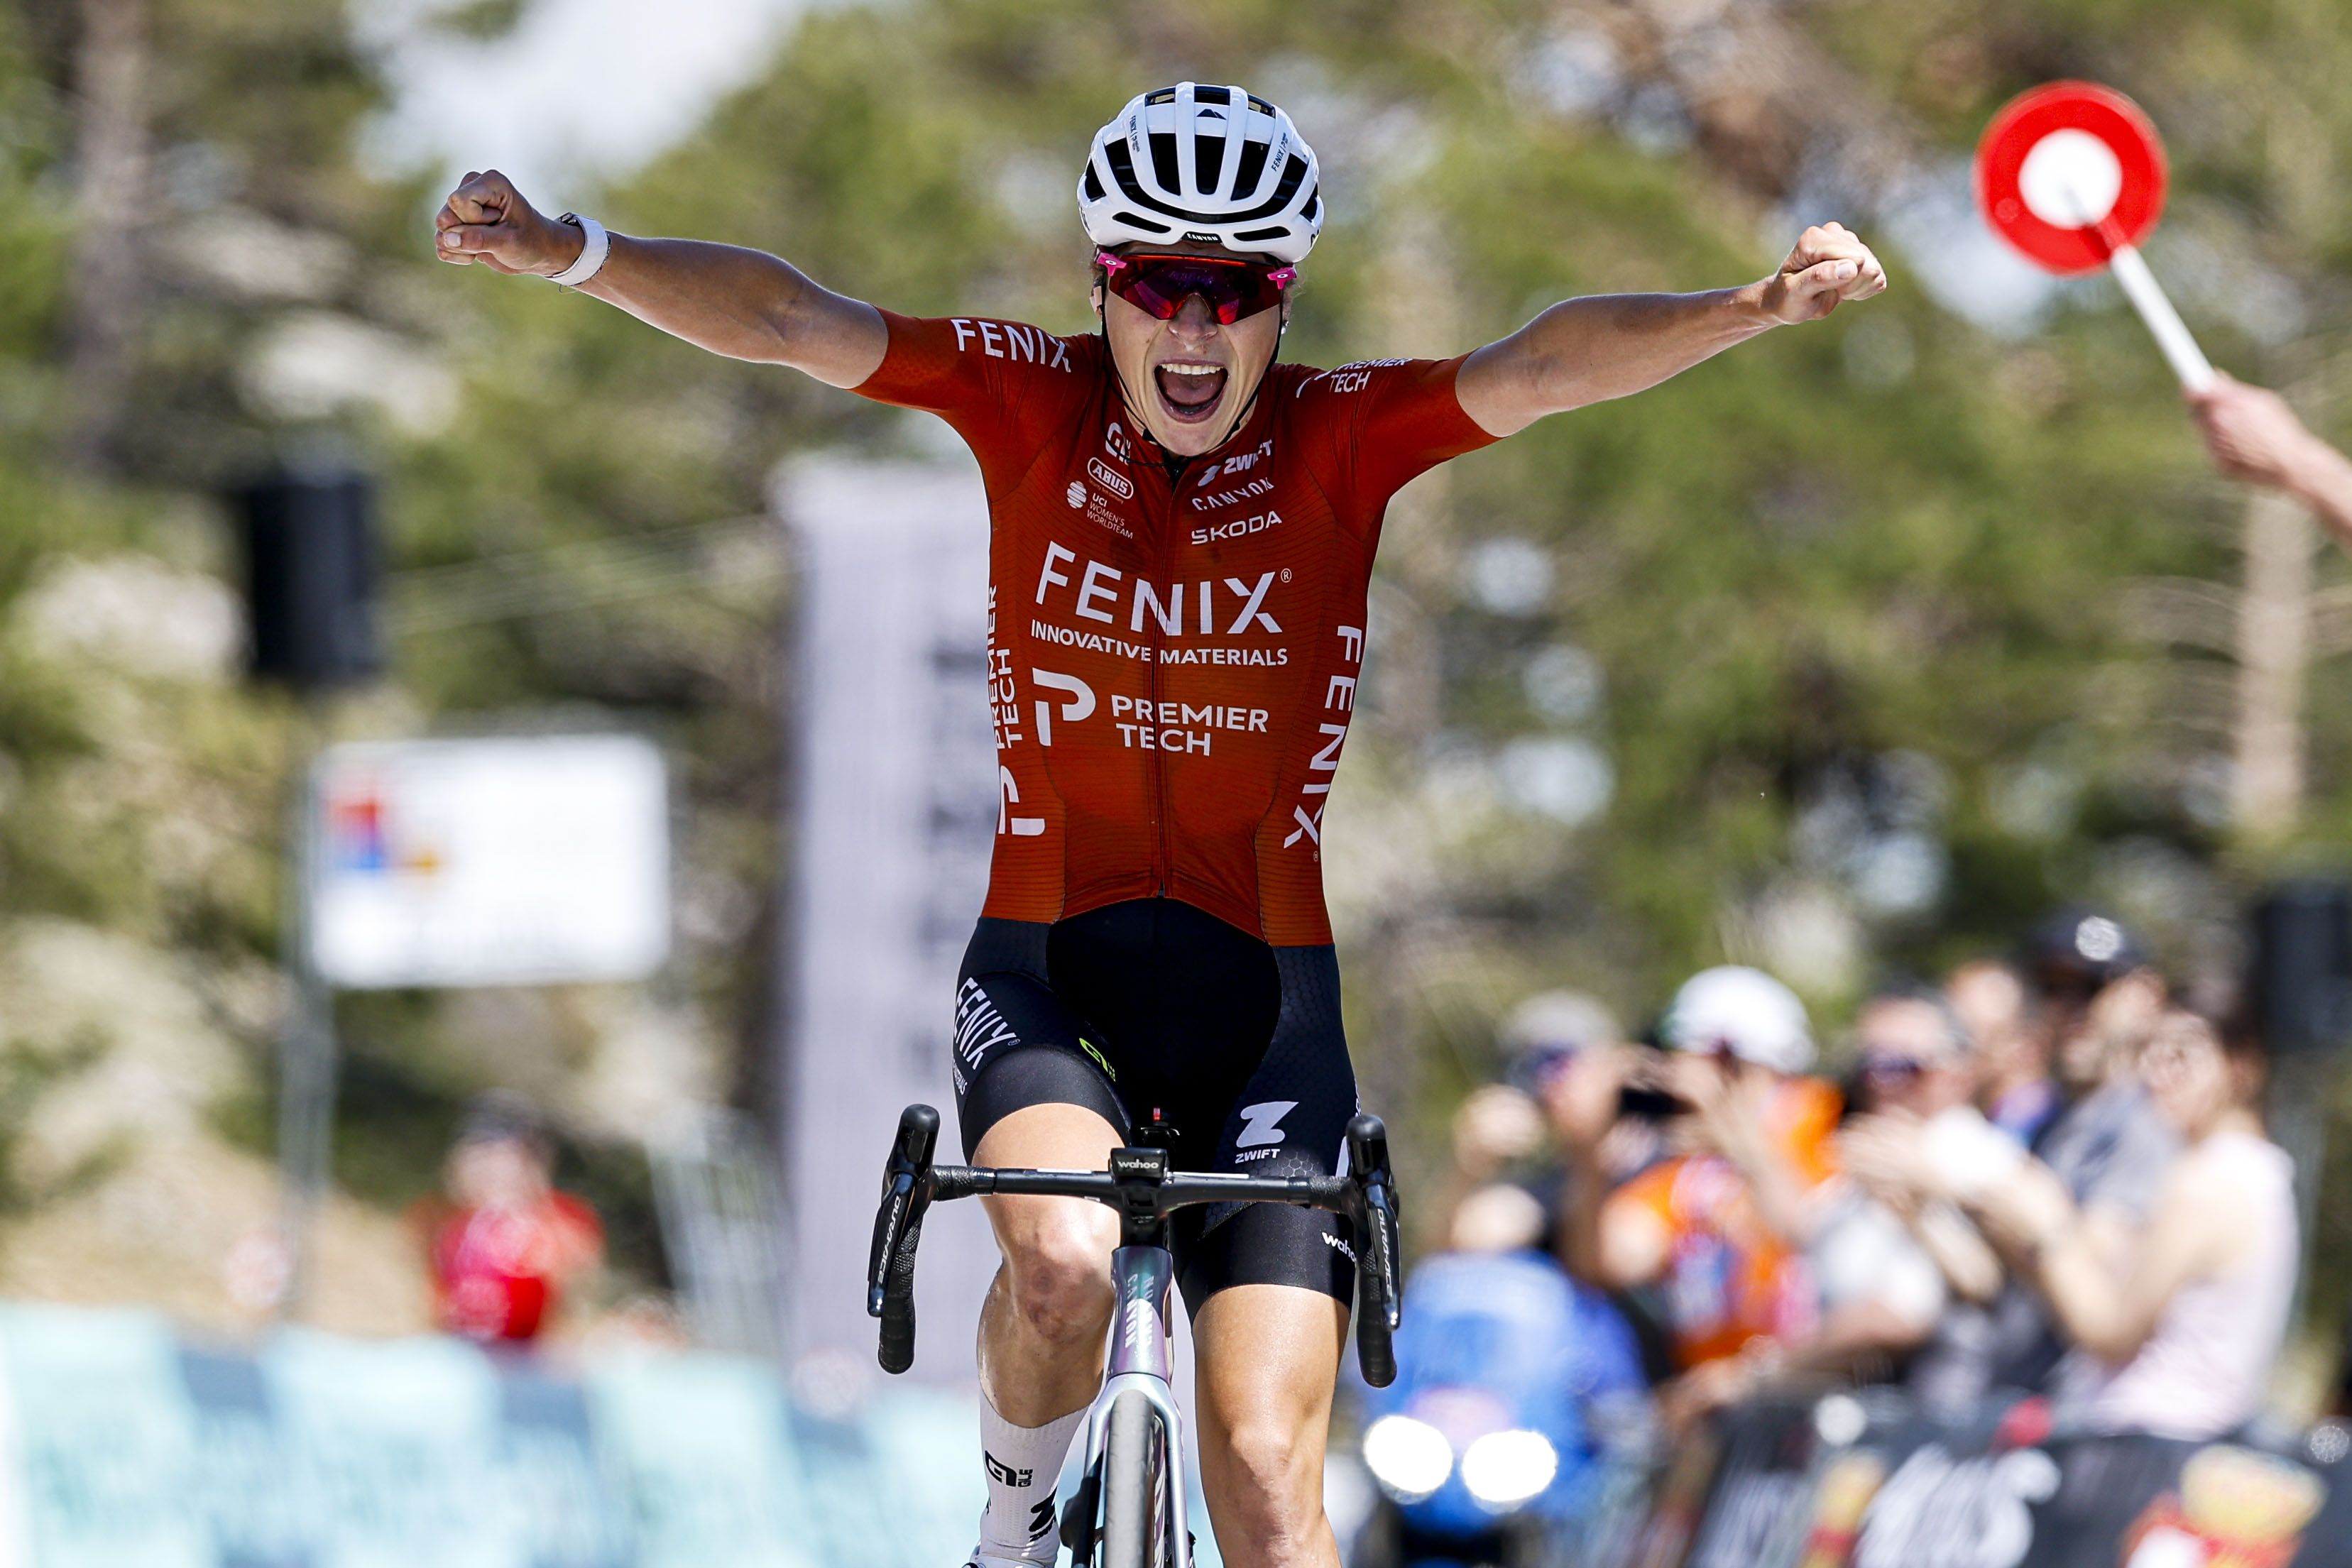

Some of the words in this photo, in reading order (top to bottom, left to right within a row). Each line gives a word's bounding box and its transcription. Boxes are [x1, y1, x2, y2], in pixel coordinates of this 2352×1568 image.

[1271, 148, 1284, 172] FENIX
[951, 319, 1071, 373] FENIX
[1329, 371, 1372, 393] TECH
[1092, 464, 1128, 495] ABUS
[1191, 476, 1275, 511] CANYON
[1090, 500, 1125, 527] WOMEN'S
[1092, 493, 1107, 508] UCI
[1087, 509, 1134, 539] WORLDTEAM
[1191, 510, 1282, 545] SKODA
[1035, 540, 1283, 637] FENIX
[1031, 618, 1151, 662] INNOVATIVE
[1160, 647, 1289, 667] MATERIALS
[987, 584, 1005, 750] PREMIER
[996, 648, 1023, 750] TECH
[1110, 694, 1269, 733] PREMIER
[1115, 723, 1211, 757] TECH
[1283, 625, 1362, 849] FENIX
[953, 977, 1017, 1070] FENIX
[1117, 1158, 1159, 1169] wahoo
[1235, 1148, 1280, 1164] ZWIFT
[877, 1195, 902, 1285] DURA-ACE
[1321, 1232, 1357, 1263] waho
[1377, 1208, 1392, 1298] DURA-ACE
